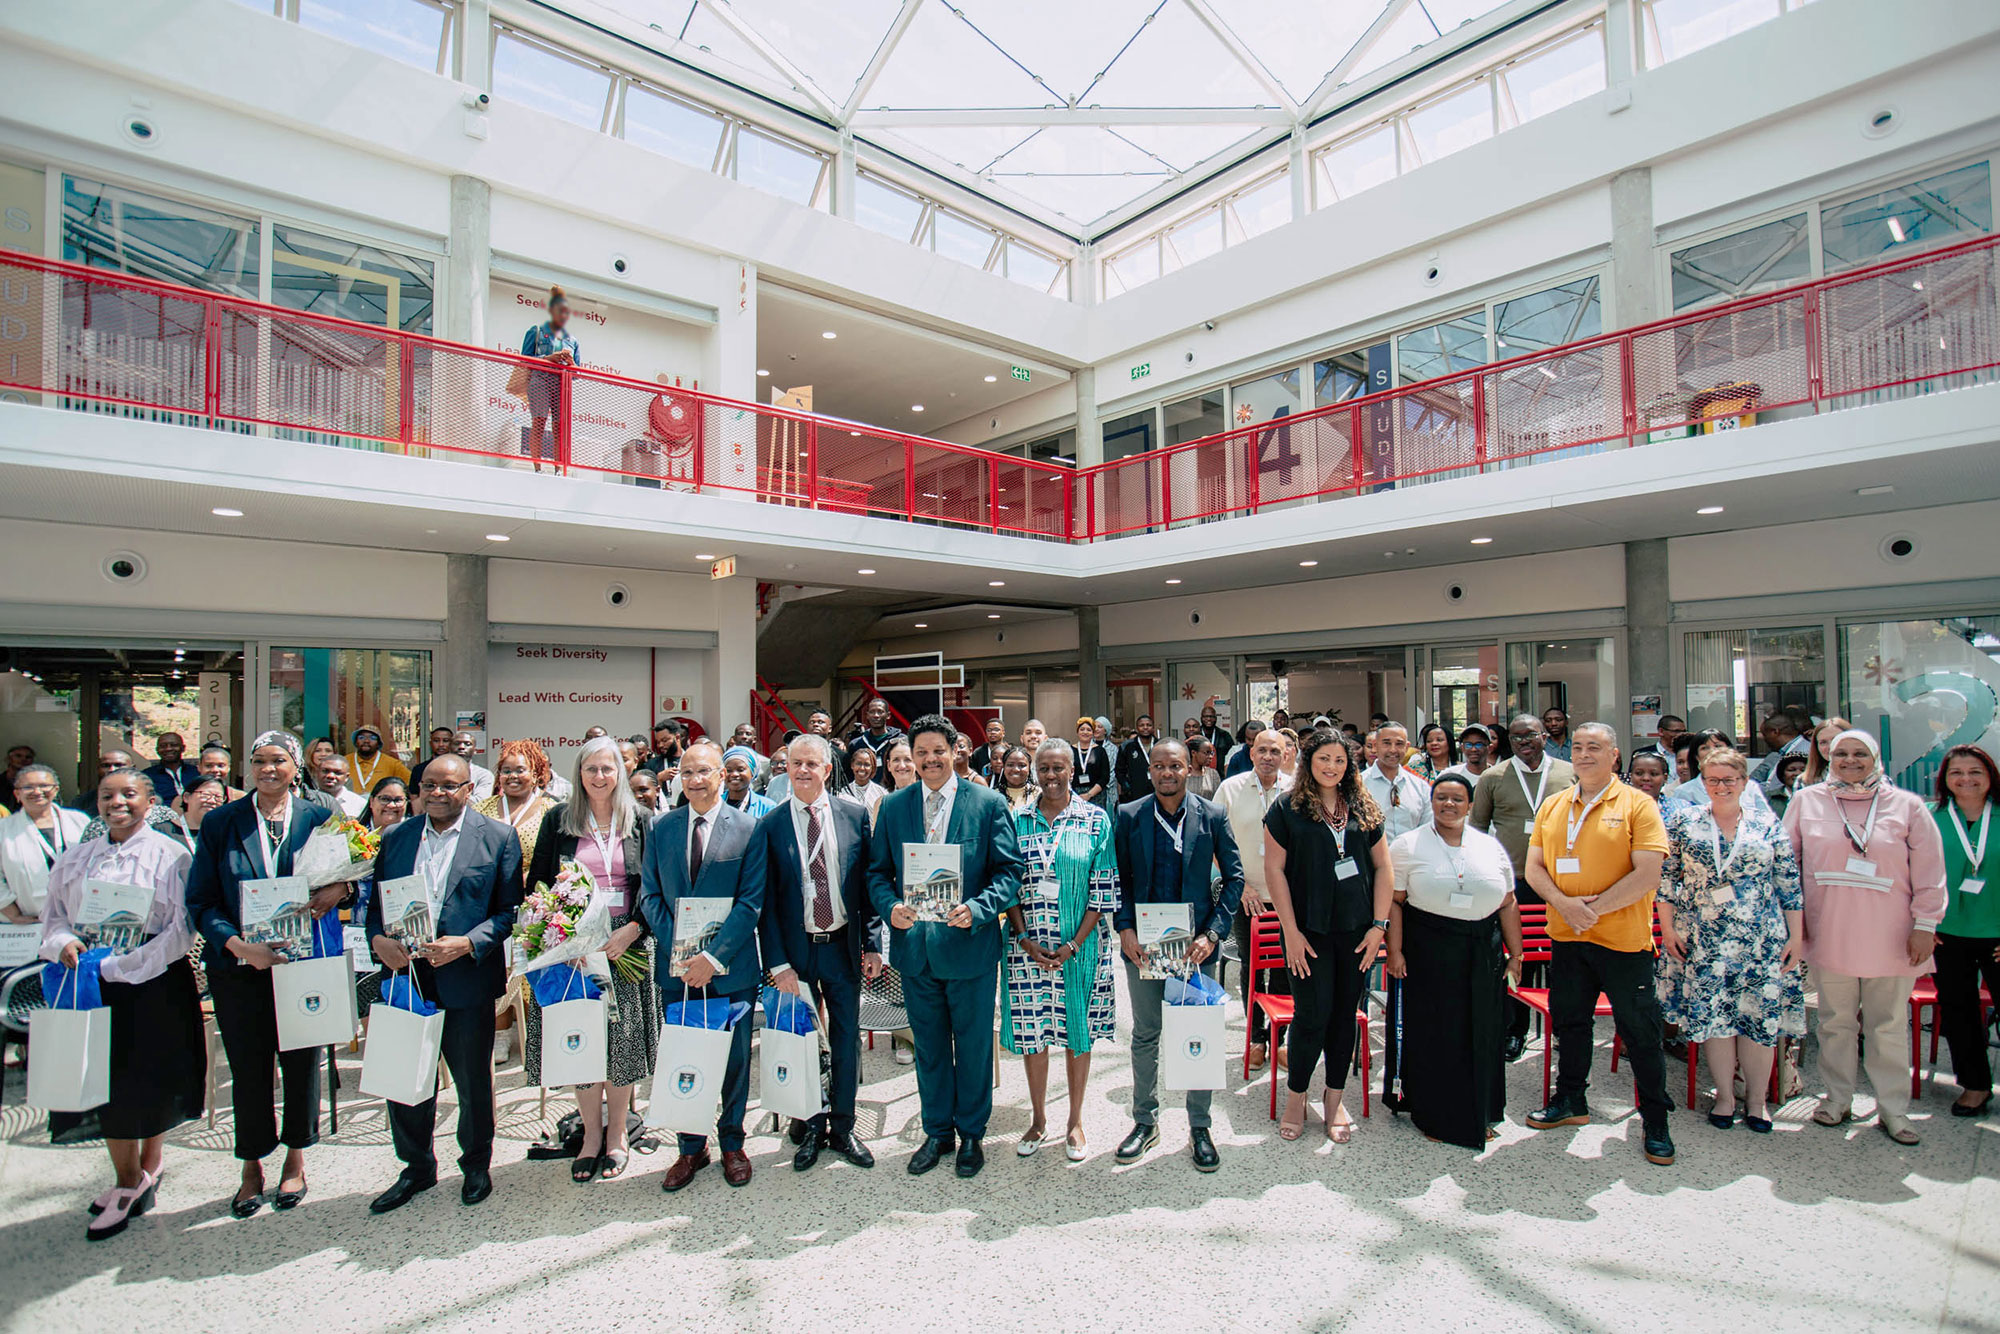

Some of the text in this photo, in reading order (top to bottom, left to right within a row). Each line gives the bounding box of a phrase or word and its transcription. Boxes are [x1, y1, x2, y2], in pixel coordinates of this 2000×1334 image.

[498, 343, 521, 356] Lea
[573, 412, 627, 430] ssibilities
[1375, 369, 1392, 493] SUDI
[516, 647, 608, 662] Seek Diversity
[498, 691, 623, 705] Lead With Curiosity
